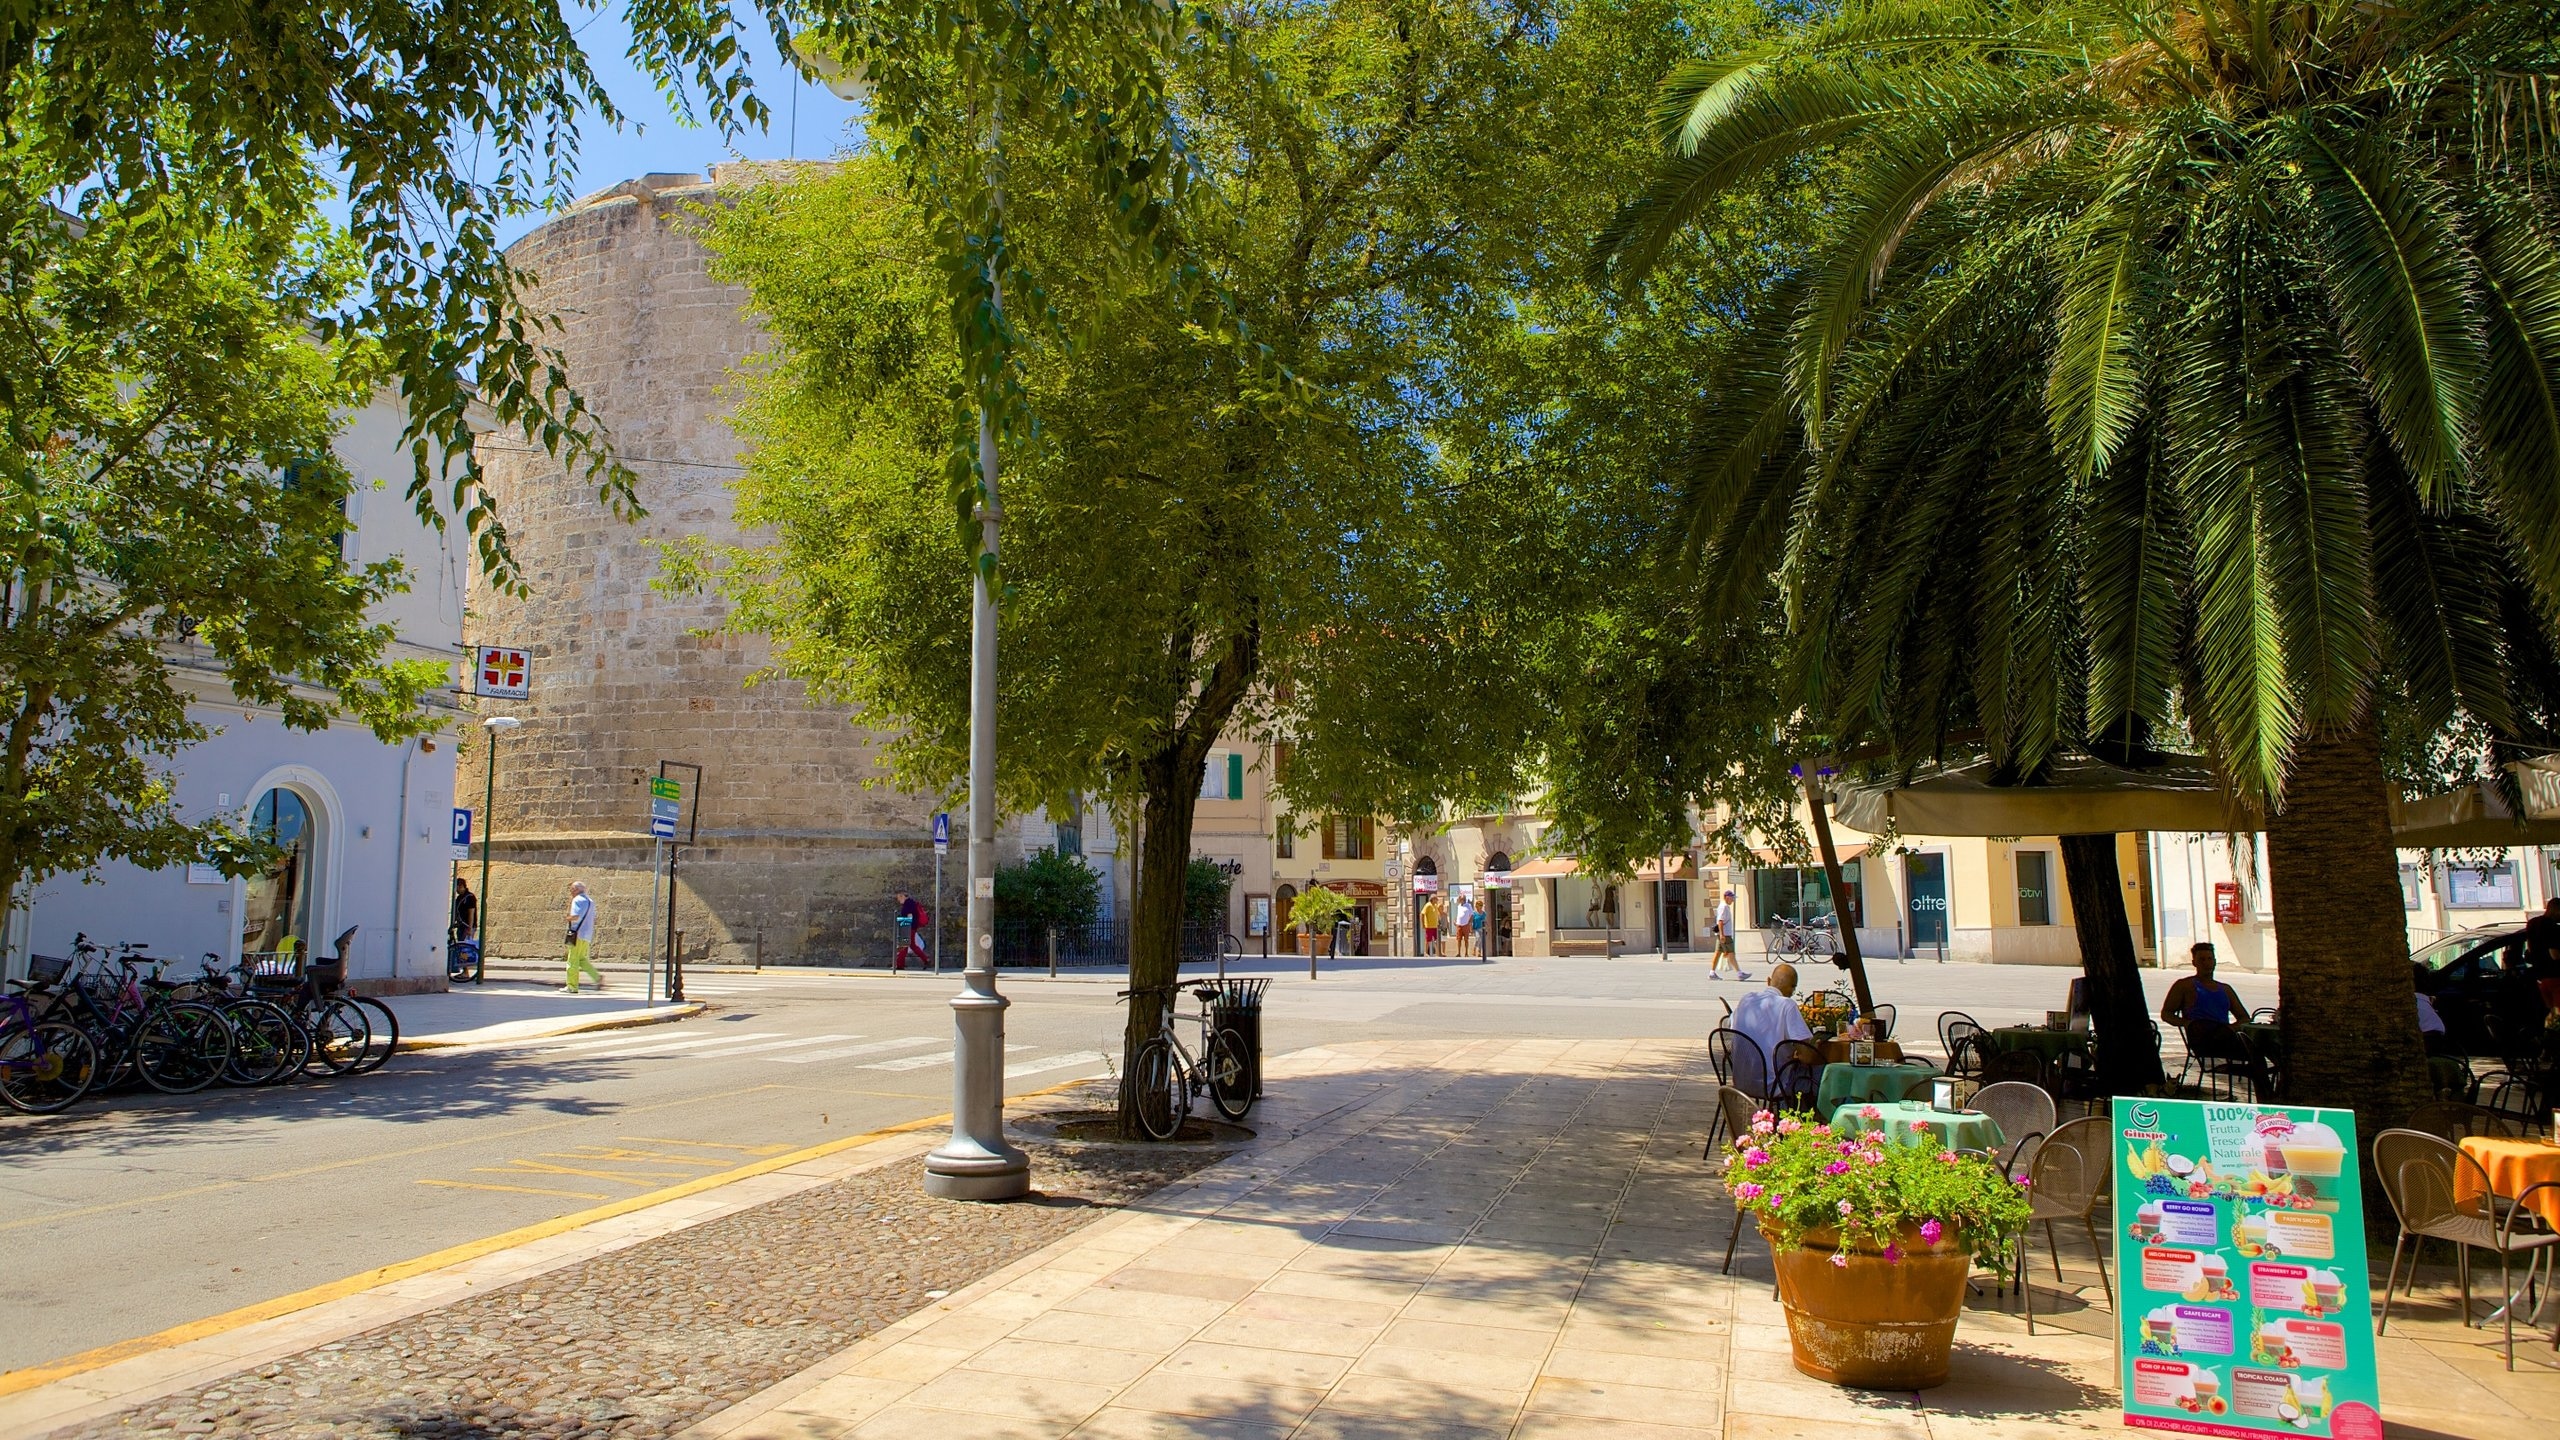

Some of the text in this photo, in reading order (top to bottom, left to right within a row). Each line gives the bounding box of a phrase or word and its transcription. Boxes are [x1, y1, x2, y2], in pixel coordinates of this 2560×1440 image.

[489, 687, 526, 697] FARMACIA
[454, 813, 467, 840] P
[1911, 895, 1946, 911] oltre
[2207, 1107, 2253, 1122] 100%
[2210, 1124, 2240, 1134] Frutta
[2212, 1136, 2246, 1146] Fresca
[2213, 1147, 2261, 1159] Naturale
[2257, 1266, 2289, 1274] STRAWBERRY
[2236, 1372, 2289, 1384] TROPICAL COLADA
